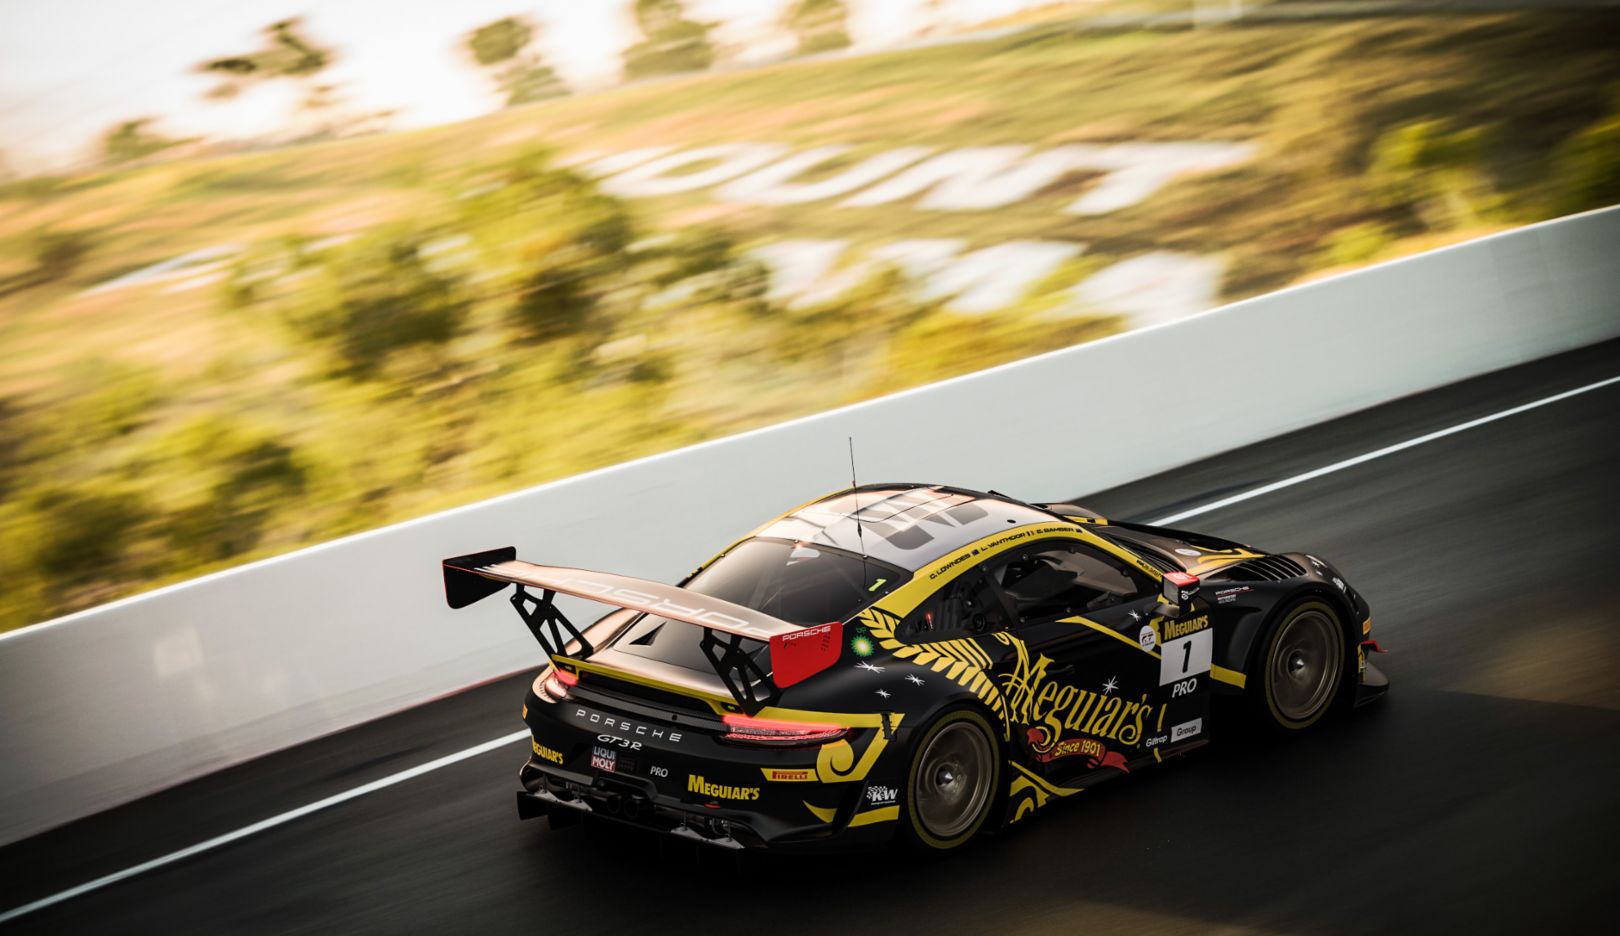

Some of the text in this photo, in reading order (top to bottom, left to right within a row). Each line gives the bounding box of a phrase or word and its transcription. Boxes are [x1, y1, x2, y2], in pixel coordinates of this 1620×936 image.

[937, 553, 971, 576] LOWNDES
[868, 578, 887, 592] 1
[782, 625, 832, 641] PORSCHE
[1182, 640, 1192, 674] 1
[992, 632, 1153, 753] Meguiar's
[1171, 678, 1198, 698] PRO
[575, 709, 683, 742] PORSCHE
[1176, 724, 1197, 737] Group
[593, 745, 616, 760] LIQUI
[1055, 740, 1101, 757] Since 1901
[591, 756, 615, 772] MOLY
[650, 765, 669, 778] PRO
[771, 770, 808, 780] PIRELLI
[872, 788, 898, 802] KW
